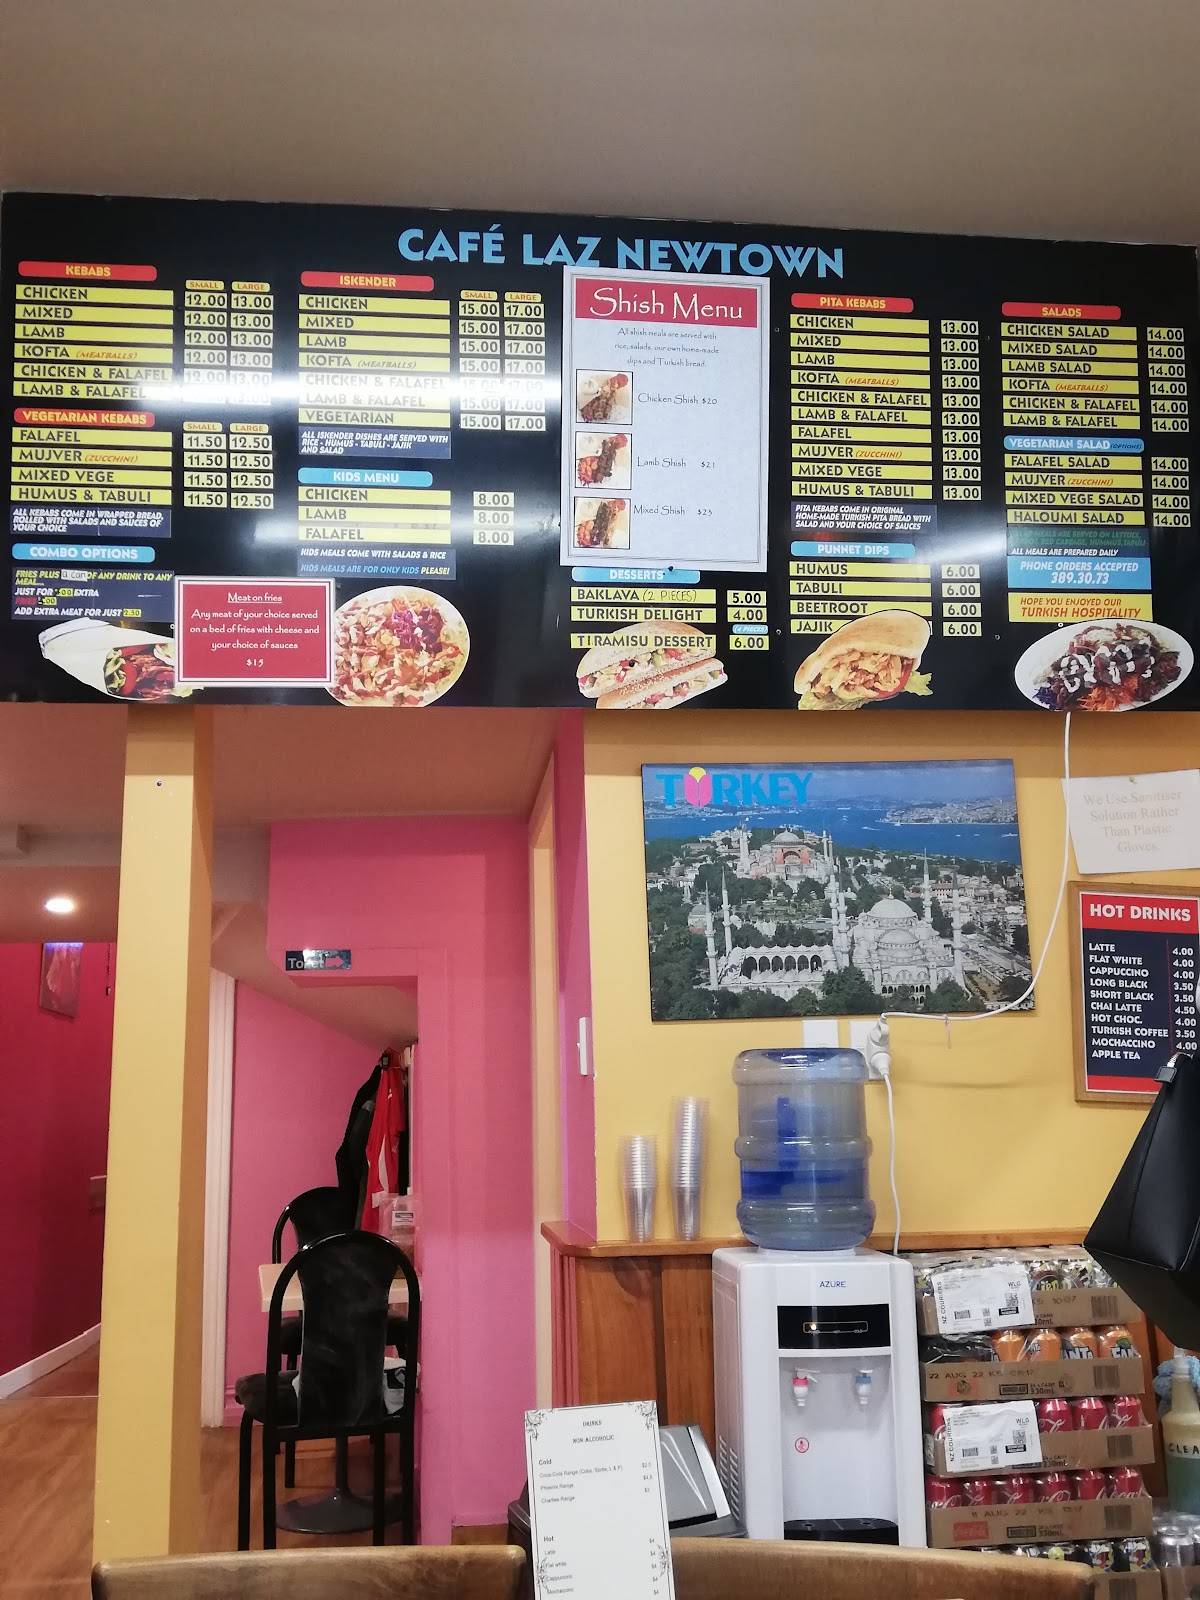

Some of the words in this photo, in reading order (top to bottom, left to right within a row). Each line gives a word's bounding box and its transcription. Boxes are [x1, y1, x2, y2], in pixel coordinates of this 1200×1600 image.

[398, 224, 505, 263] CAFÉ
[523, 234, 602, 267] LAZ
[618, 237, 843, 279] NEWTOWN
[66, 265, 111, 277] KEBABS
[340, 276, 396, 287] ISKENDER
[23, 287, 88, 299] CHICKEN
[186, 294, 225, 306] 12.00
[233, 296, 271, 308] 13.00
[820, 297, 843, 306] PITA
[847, 298, 885, 308] KEBABS
[306, 298, 367, 309] CHICKEN
[461, 304, 497, 315] 15.00
[507, 306, 541, 317] 17.00
[590, 288, 664, 316] Shish
[673, 292, 742, 320] Menu
[23, 307, 73, 318] MIXED
[186, 314, 225, 325] 12.00
[233, 316, 270, 327] 13.00
[1042, 308, 1081, 317] SALADS
[306, 318, 354, 328] MIXED
[461, 323, 497, 334] 15.00
[797, 316, 853, 328] CHICKEN
[943, 323, 976, 333] 13.00
[22, 326, 64, 337] LAMB
[186, 333, 225, 345] 12.00
[1008, 325, 1063, 336] CHICKEN
[1068, 327, 1109, 337] SALAD
[1149, 330, 1182, 340] 14.00
[306, 337, 346, 348] LAMB
[797, 336, 841, 346] MIXED
[943, 341, 976, 351] 13.00
[22, 345, 70, 357] KOFTA
[76, 351, 137, 359] (MEATBALLS)
[1008, 344, 1050, 354] MIXED
[1056, 345, 1097, 355] SALAD
[798, 354, 834, 364] LAMB
[22, 365, 86, 377] CHICKEN
[93, 368, 102, 377] &
[109, 368, 169, 381] FALAFEL
[638, 393, 672, 403] Chicken
[674, 395, 699, 405] Shish
[23, 411, 97, 423] VEGETARIAN
[101, 412, 146, 424] KEBABS
[306, 411, 394, 424] VEGETARIAN
[798, 428, 851, 438] FALAFEL
[20, 430, 80, 442] FALAFEL
[187, 436, 222, 447] 11.50
[232, 437, 270, 449] 12.50
[1010, 439, 1073, 448] VEGETARIAN
[1077, 440, 1110, 449] SALAD
[19, 450, 82, 462] MUJVER
[85, 455, 138, 463] (ZUCCHINI)
[799, 446, 853, 457] MUJVER
[637, 457, 659, 467] Lamb
[662, 459, 686, 468] Shish
[19, 470, 70, 481] MIXED
[76, 471, 114, 483] VEGE
[333, 472, 360, 482] KIDS
[364, 473, 399, 483] MENU
[19, 488, 77, 500] HUMUS
[84, 490, 93, 500] &
[100, 491, 151, 502] TABULI
[306, 489, 368, 500] CHICKEN
[479, 494, 509, 505] 8.00
[13, 508, 27, 516] ALL
[28, 509, 59, 517] KEBABS
[61, 509, 84, 518] COME
[86, 510, 96, 518] IN
[98, 510, 135, 519] WRAPPED
[136, 511, 163, 520] BREAD,
[634, 505, 659, 515] Mixed
[661, 506, 685, 516] Shish
[1014, 512, 1077, 523] HALOUMI
[1083, 513, 1124, 523] SALAD
[1155, 515, 1188, 525] 14.00
[306, 528, 364, 540] FALAFEL
[30, 547, 77, 558] COMBO
[82, 549, 138, 560] OPTIONS
[818, 545, 860, 554] PUNNET
[864, 546, 889, 555] DIPS
[797, 564, 847, 574] HUMUS
[1020, 562, 1053, 570] PHONE
[1055, 562, 1091, 570] ORDERS
[1094, 563, 1138, 571] ACCEPTED
[610, 570, 663, 580] DESSERTS
[1051, 572, 1109, 584] 389.30.73
[797, 583, 842, 593] TABULI
[947, 585, 975, 595] 6.00
[228, 592, 251, 603] Meat
[264, 592, 282, 602] fries
[578, 589, 639, 599] BAKLAVA
[733, 593, 760, 603] 5.00
[1066, 598, 1100, 606] ENJOYED
[797, 603, 867, 613] BEETROOT
[1021, 607, 1067, 617] TURKISH
[1072, 608, 1140, 618] HOSPITALITY
[192, 609, 210, 620] Any
[244, 611, 262, 620] your
[264, 610, 290, 618] choice
[292, 610, 318, 618] served
[577, 609, 637, 620] TURKISH
[645, 609, 702, 620] DELIGHT
[734, 610, 762, 620] 4.00
[797, 622, 832, 632] JAJIK
[948, 624, 976, 634] 6.00
[655, 636, 712, 647] DESSERT
[735, 638, 764, 648] 6.00
[1090, 904, 1124, 917] HOT
[1131, 906, 1191, 921] DRINKS
[1089, 943, 1115, 952] LATTE
[1173, 948, 1193, 956] 4.00
[1089, 955, 1110, 963] FLAT
[1113, 956, 1142, 965] WHITE
[1090, 967, 1149, 977] CAPPUCCINO
[1090, 978, 1116, 987] LONG
[1119, 980, 1147, 988] BLACK
[1091, 1002, 1112, 1010] CHAI
[1115, 1003, 1142, 1012] LATTE
[1092, 1026, 1131, 1035] TURKISH
[1135, 1028, 1168, 1037] COFFEE
[1092, 1038, 1155, 1048] MOCHACCINO
[1092, 1051, 1120, 1059] APPLE
[1123, 1051, 1140, 1059] TEA
